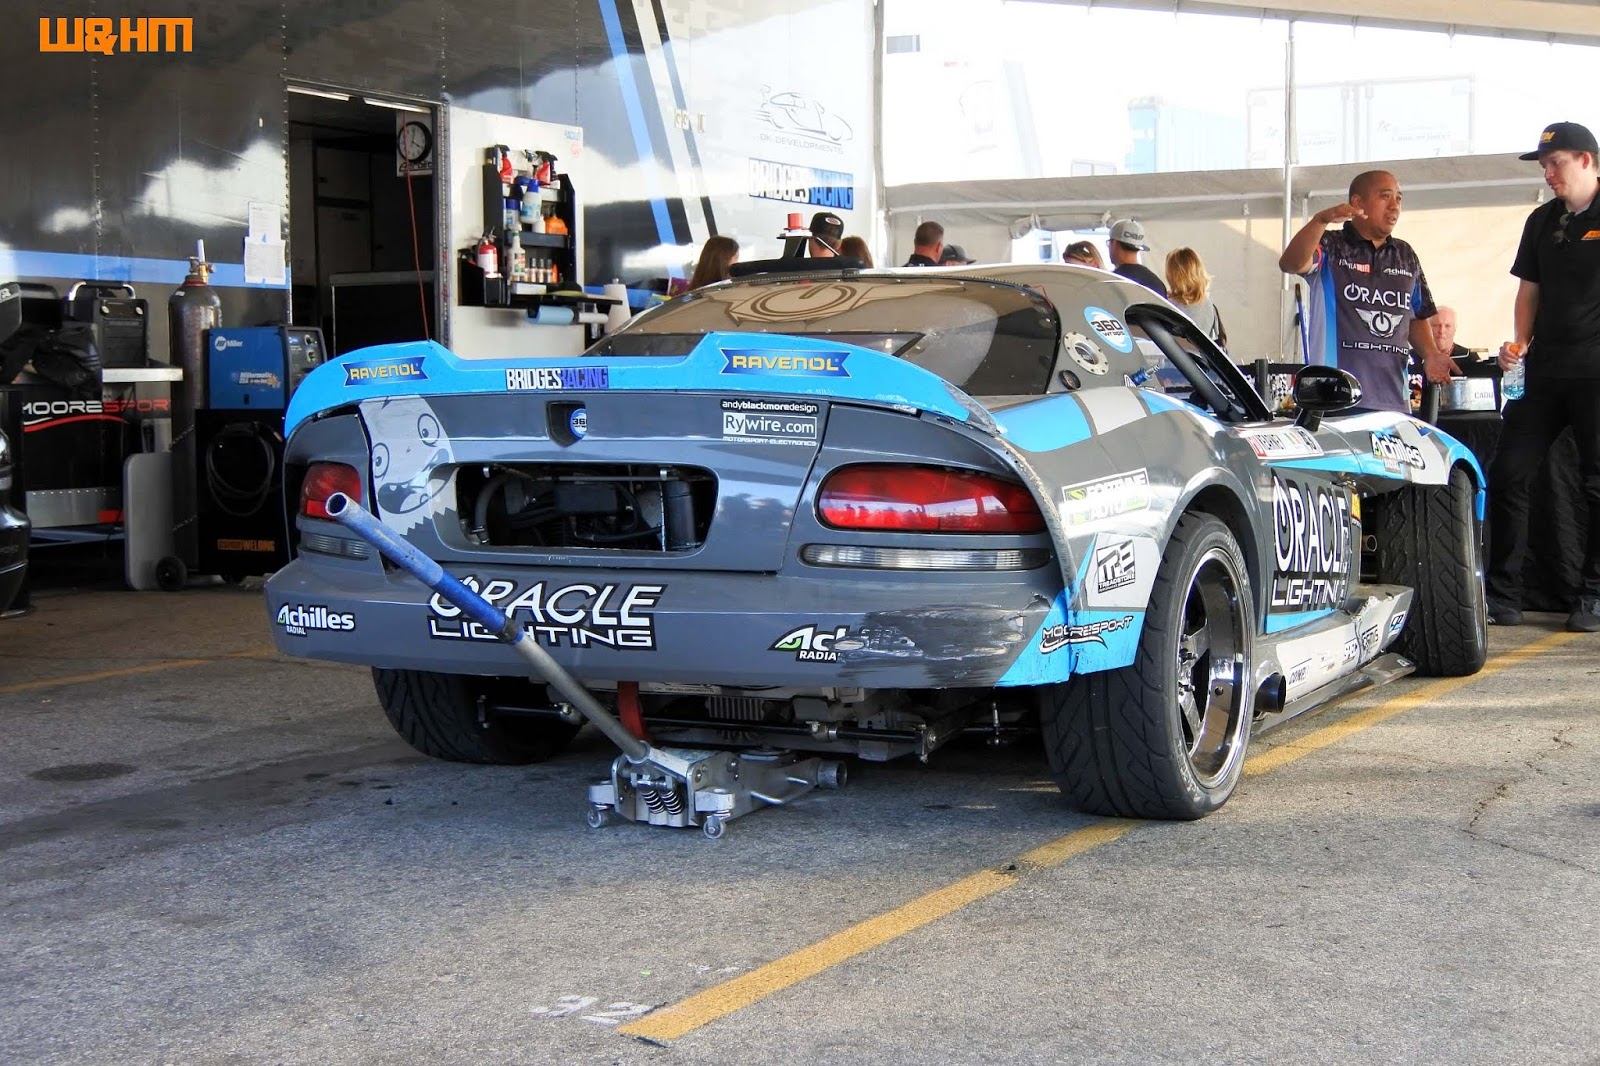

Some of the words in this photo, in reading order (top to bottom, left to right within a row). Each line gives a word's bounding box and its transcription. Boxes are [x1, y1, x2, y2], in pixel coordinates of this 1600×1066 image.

[1344, 282, 1411, 310] ORACLE
[1090, 319, 1124, 332] 360
[349, 362, 420, 380] RAVENOL
[732, 355, 839, 371] RAVENOL
[722, 400, 818, 413] andyblackmoredesign
[725, 414, 814, 434] Rywire.com
[1373, 432, 1425, 469] Achilles
[277, 604, 355, 630] Achilles
[286, 625, 306, 635] RADIAL
[799, 650, 841, 661] RADIA
